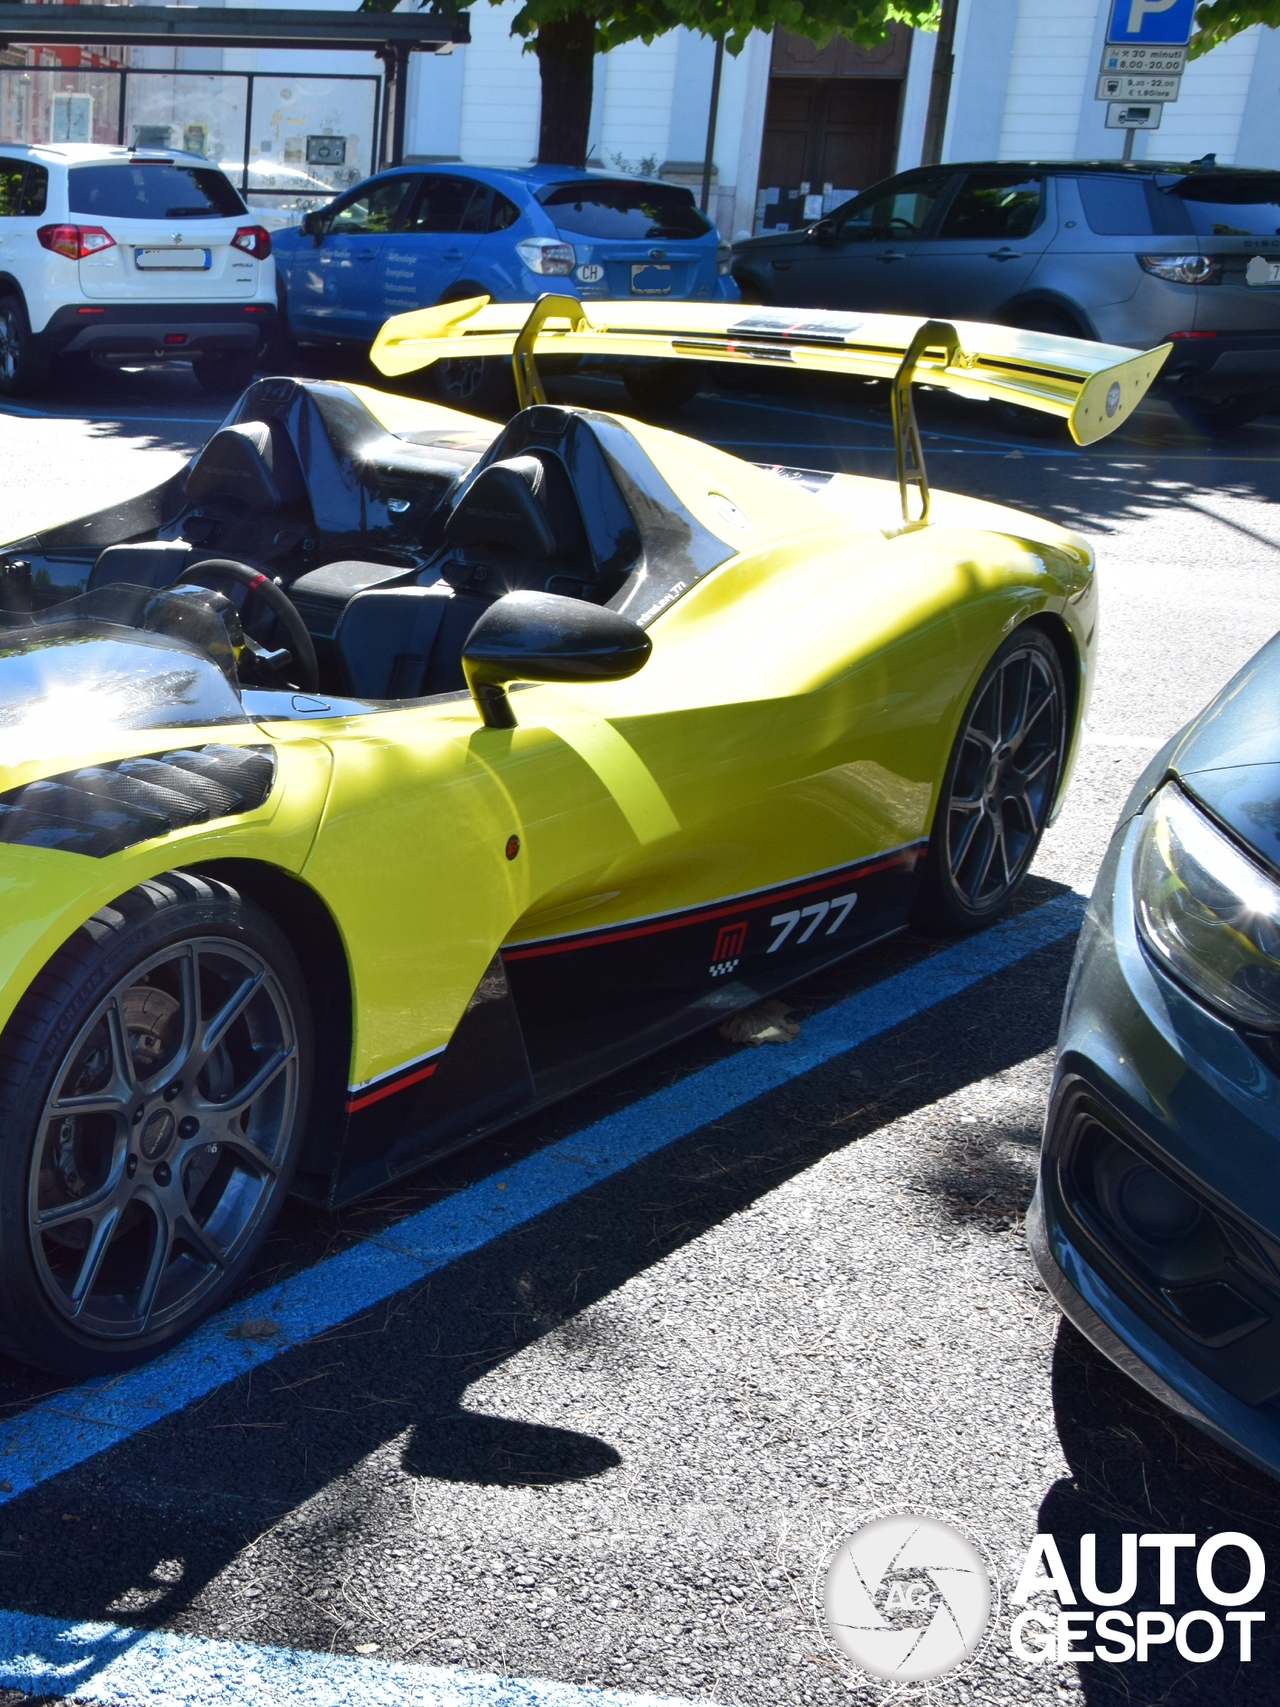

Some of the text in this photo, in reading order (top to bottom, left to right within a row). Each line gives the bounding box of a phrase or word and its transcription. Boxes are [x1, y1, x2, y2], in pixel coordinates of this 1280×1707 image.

[1126, 0, 1177, 33] P
[1132, 50, 1183, 59] 30 minuti
[582, 266, 598, 280] CH
[766, 892, 858, 954] 777
[47, 969, 102, 1055] MICHELIN
